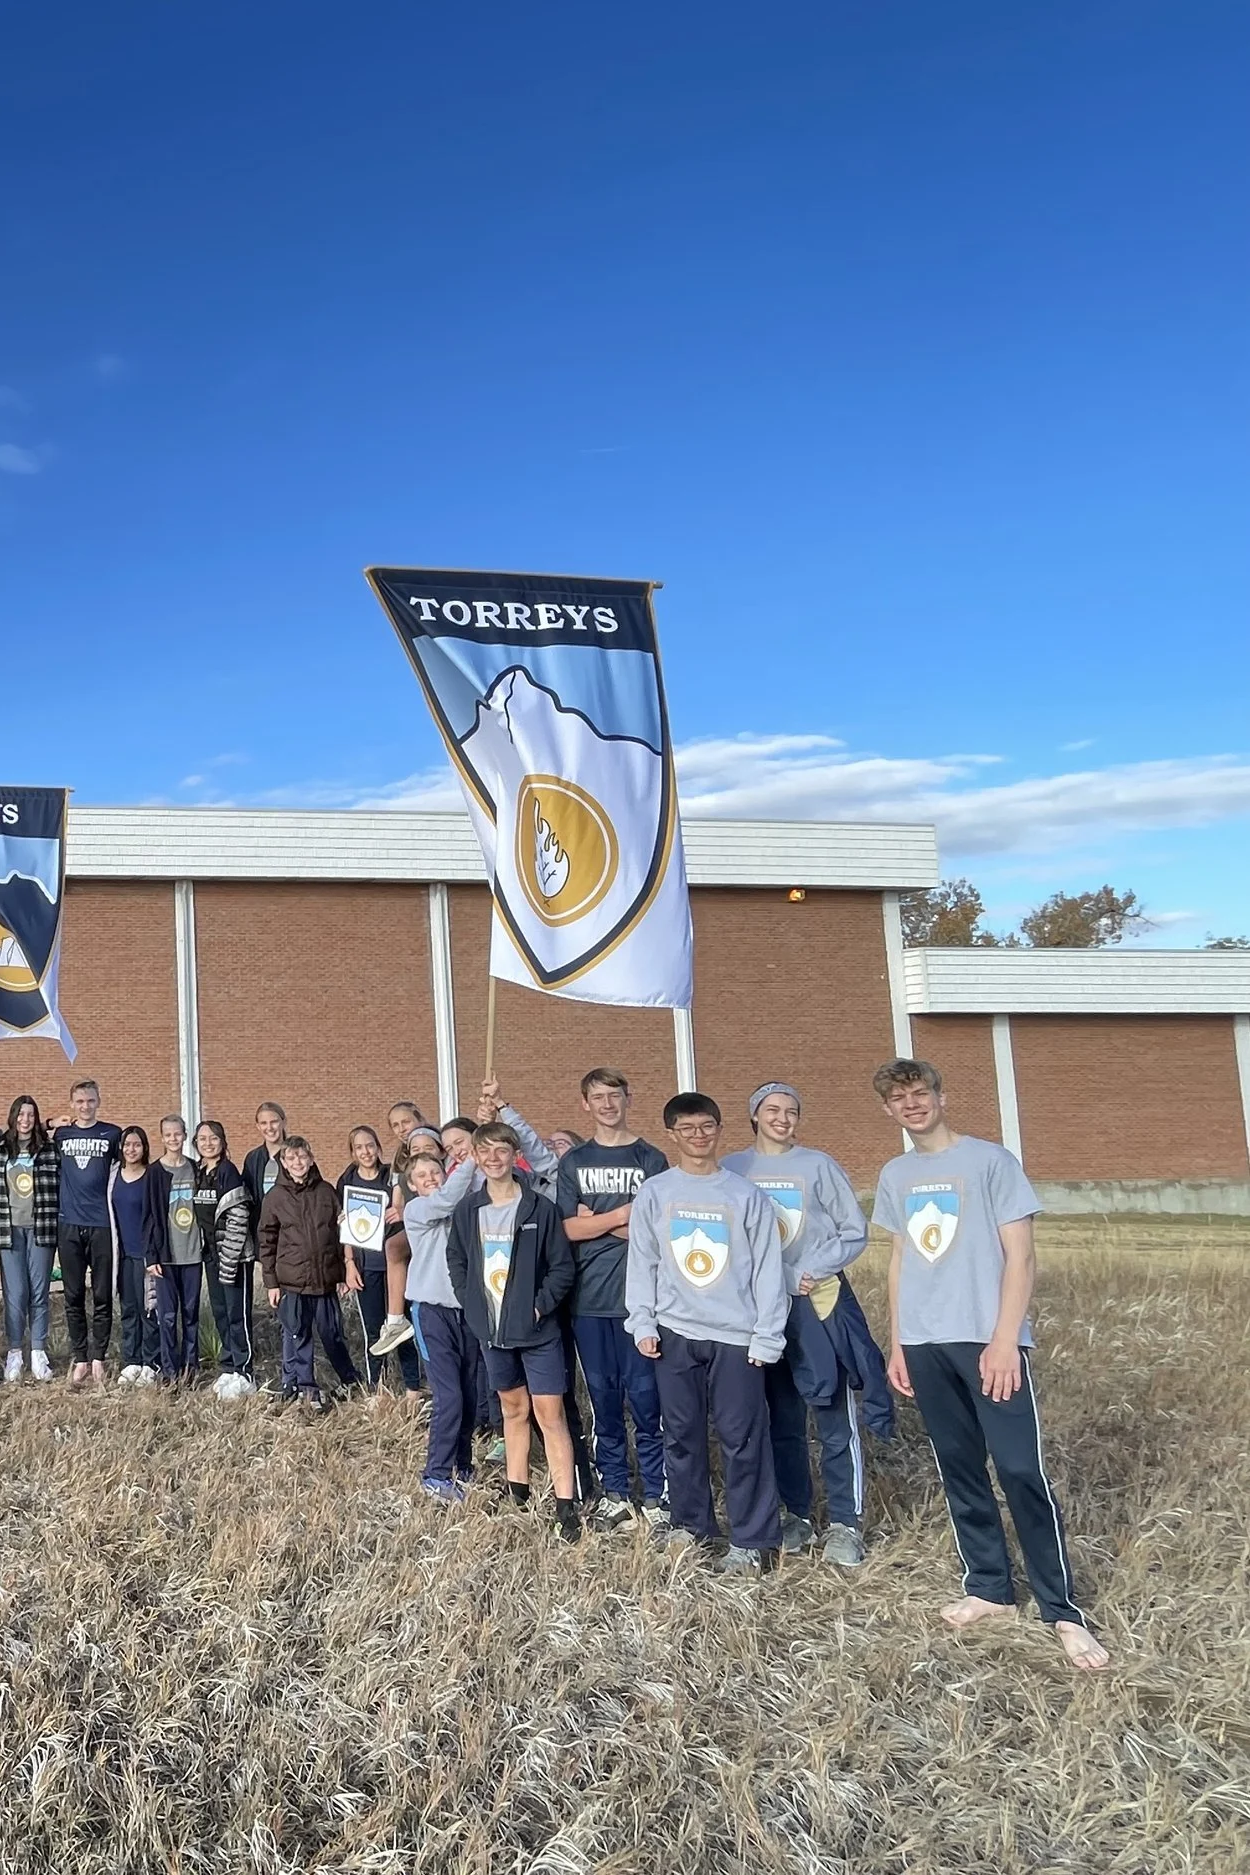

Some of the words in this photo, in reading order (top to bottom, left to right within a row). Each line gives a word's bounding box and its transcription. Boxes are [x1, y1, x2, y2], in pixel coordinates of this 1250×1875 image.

[409, 596, 619, 633] TORREYS
[61, 1138, 110, 1153] KNIGHTS
[576, 1166, 646, 1195] KNIGHTS
[677, 1210, 723, 1221] TORREYS
